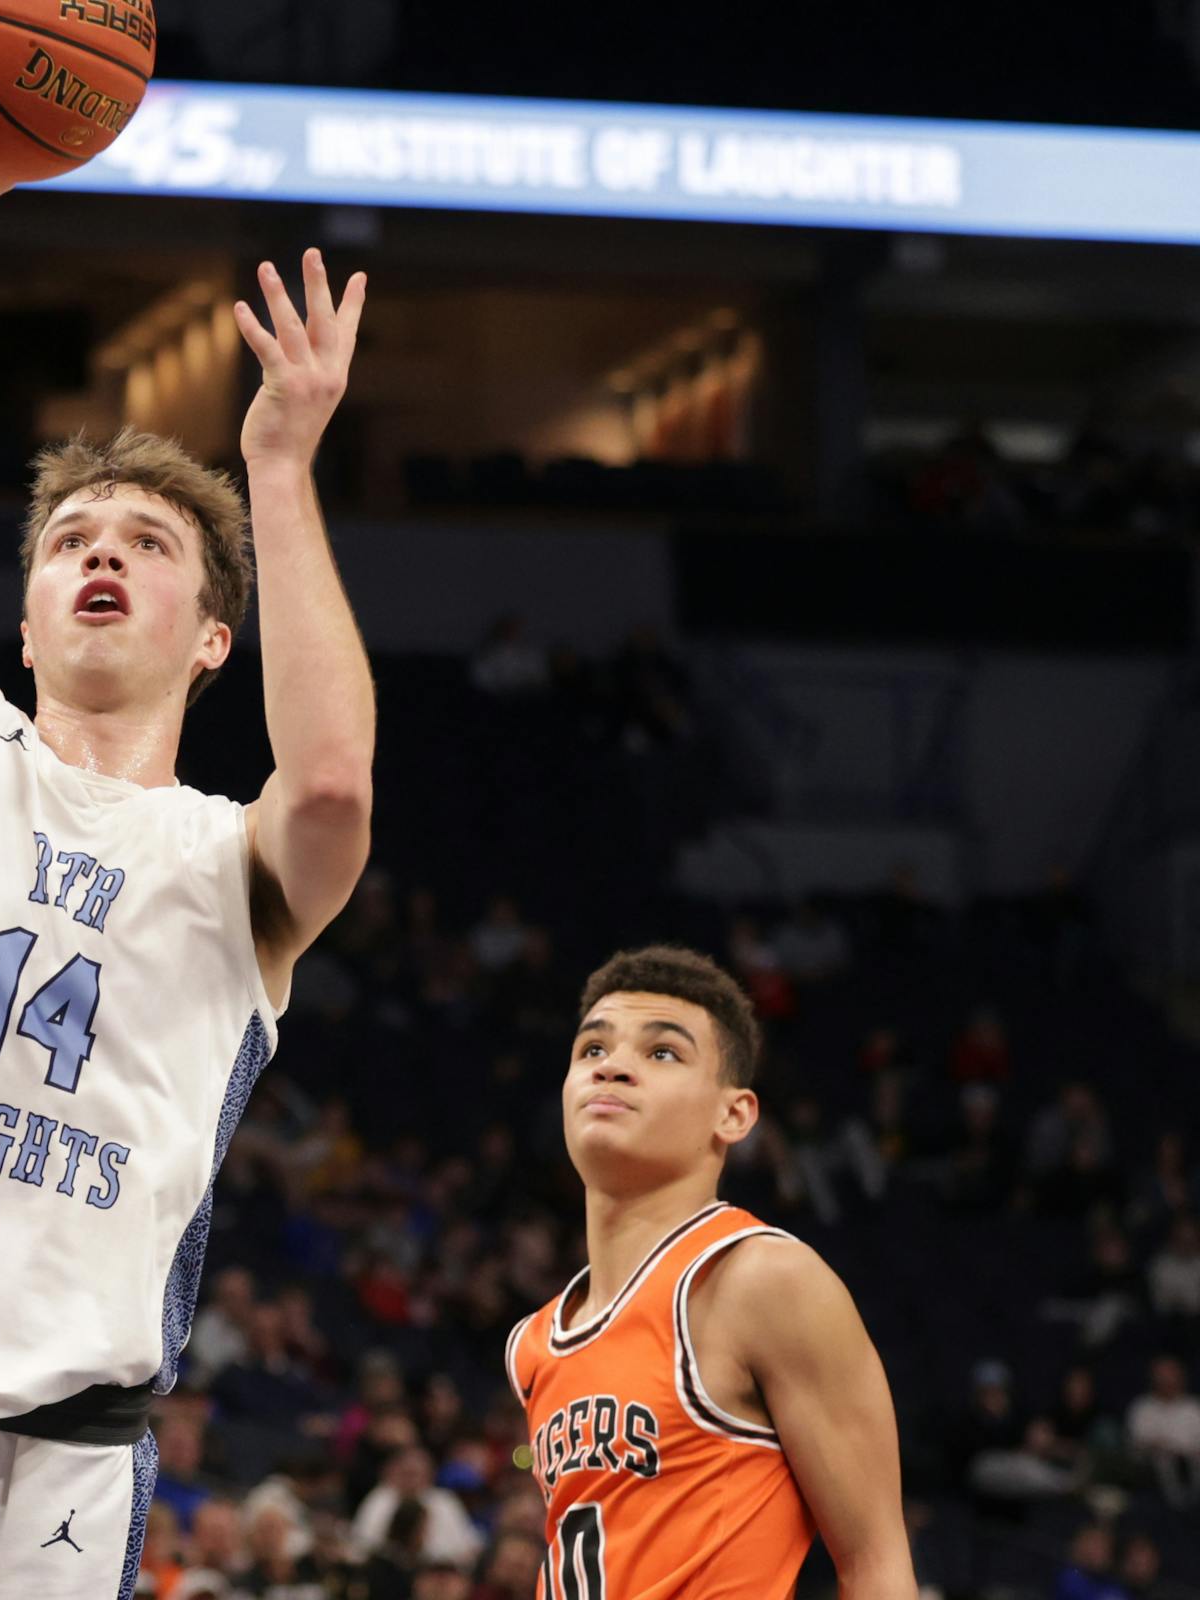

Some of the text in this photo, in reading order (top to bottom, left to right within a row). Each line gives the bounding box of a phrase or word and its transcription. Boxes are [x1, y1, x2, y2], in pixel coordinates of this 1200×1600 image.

[306, 114, 585, 188] INSTITUTE
[594, 127, 669, 192] OF
[678, 132, 961, 207] LAUGHTER
[532, 1394, 660, 1504] IGERS
